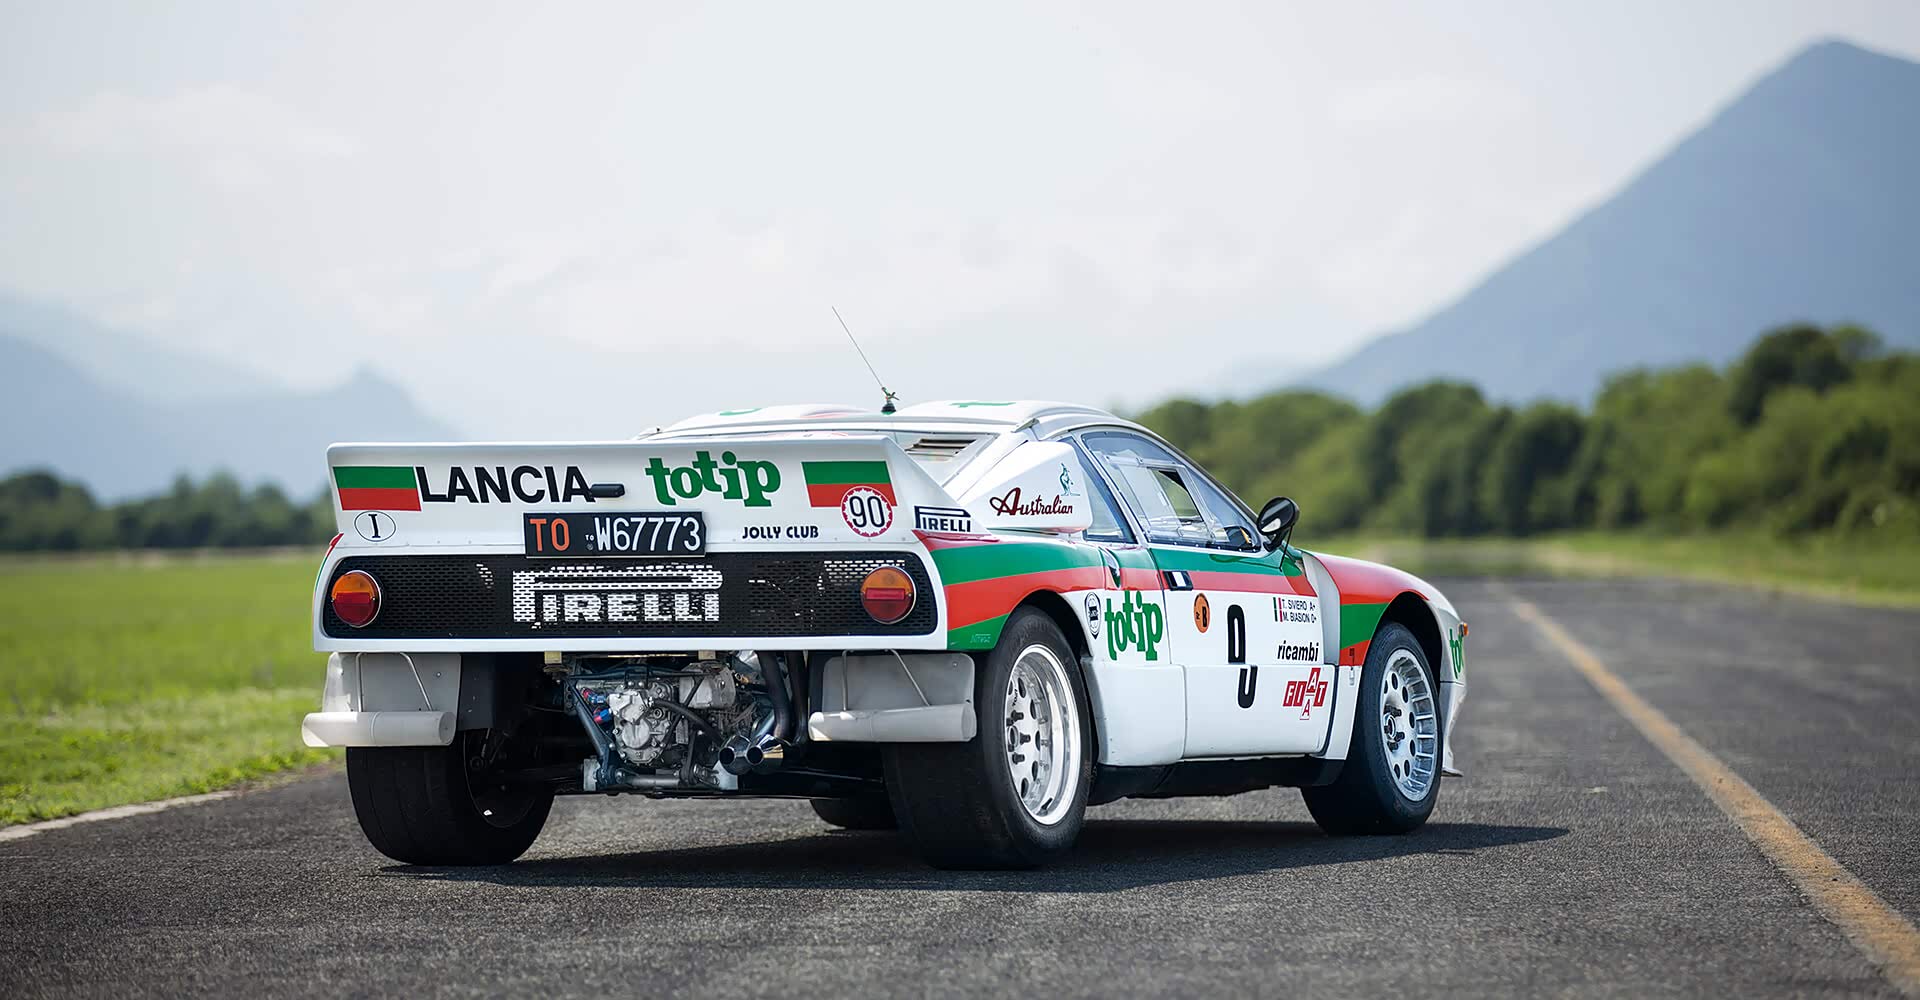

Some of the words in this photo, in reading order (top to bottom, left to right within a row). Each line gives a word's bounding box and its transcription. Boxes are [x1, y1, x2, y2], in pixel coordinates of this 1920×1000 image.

[415, 465, 596, 504] LANCIA
[644, 450, 781, 507] totip
[849, 495, 885, 528] 90
[914, 505, 971, 532] PIRELLI
[989, 487, 1073, 516] Australian
[529, 518, 570, 552] TO
[594, 516, 701, 552] W67773
[742, 526, 782, 540] JOLLY
[786, 525, 819, 539] CLUB
[513, 570, 723, 622] PIRELLI
[1104, 590, 1163, 661] totip
[1277, 640, 1319, 662] ricambi
[1282, 667, 1328, 707] FIAT
